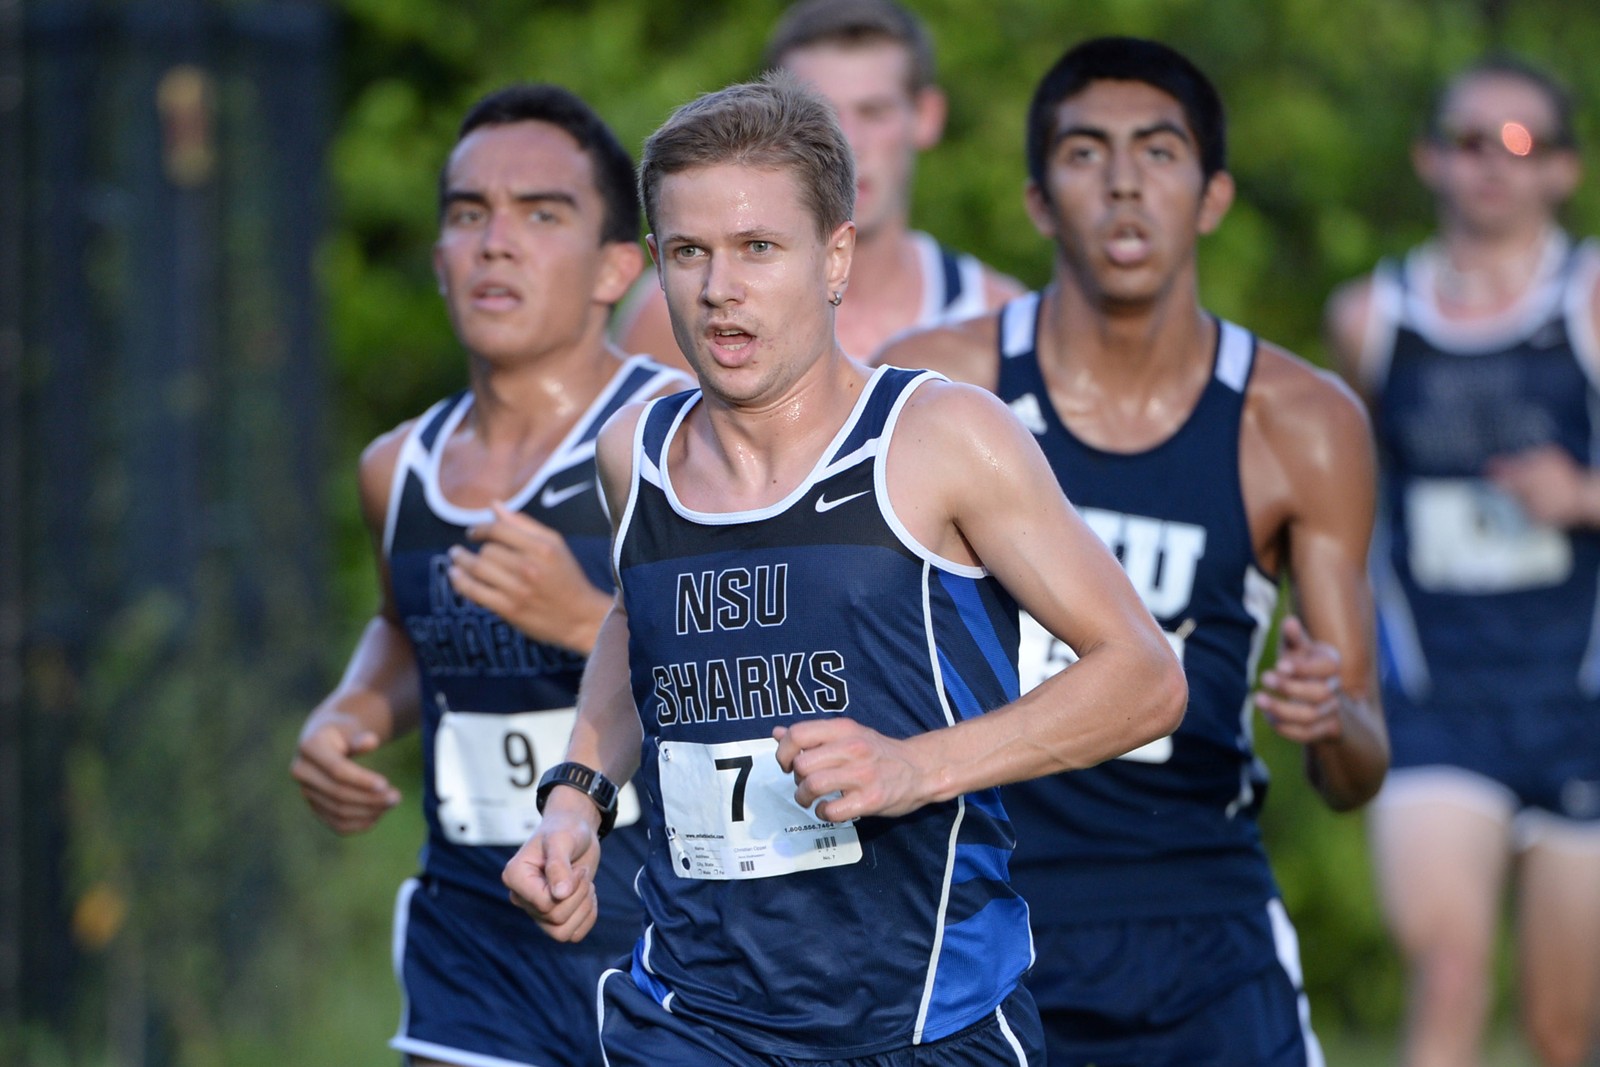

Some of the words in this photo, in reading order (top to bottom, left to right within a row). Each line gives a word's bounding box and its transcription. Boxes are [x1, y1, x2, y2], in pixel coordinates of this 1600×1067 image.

[676, 563, 788, 635] NSU
[652, 650, 849, 727] SHARKS
[503, 732, 536, 789] 9
[714, 755, 753, 822] 7
